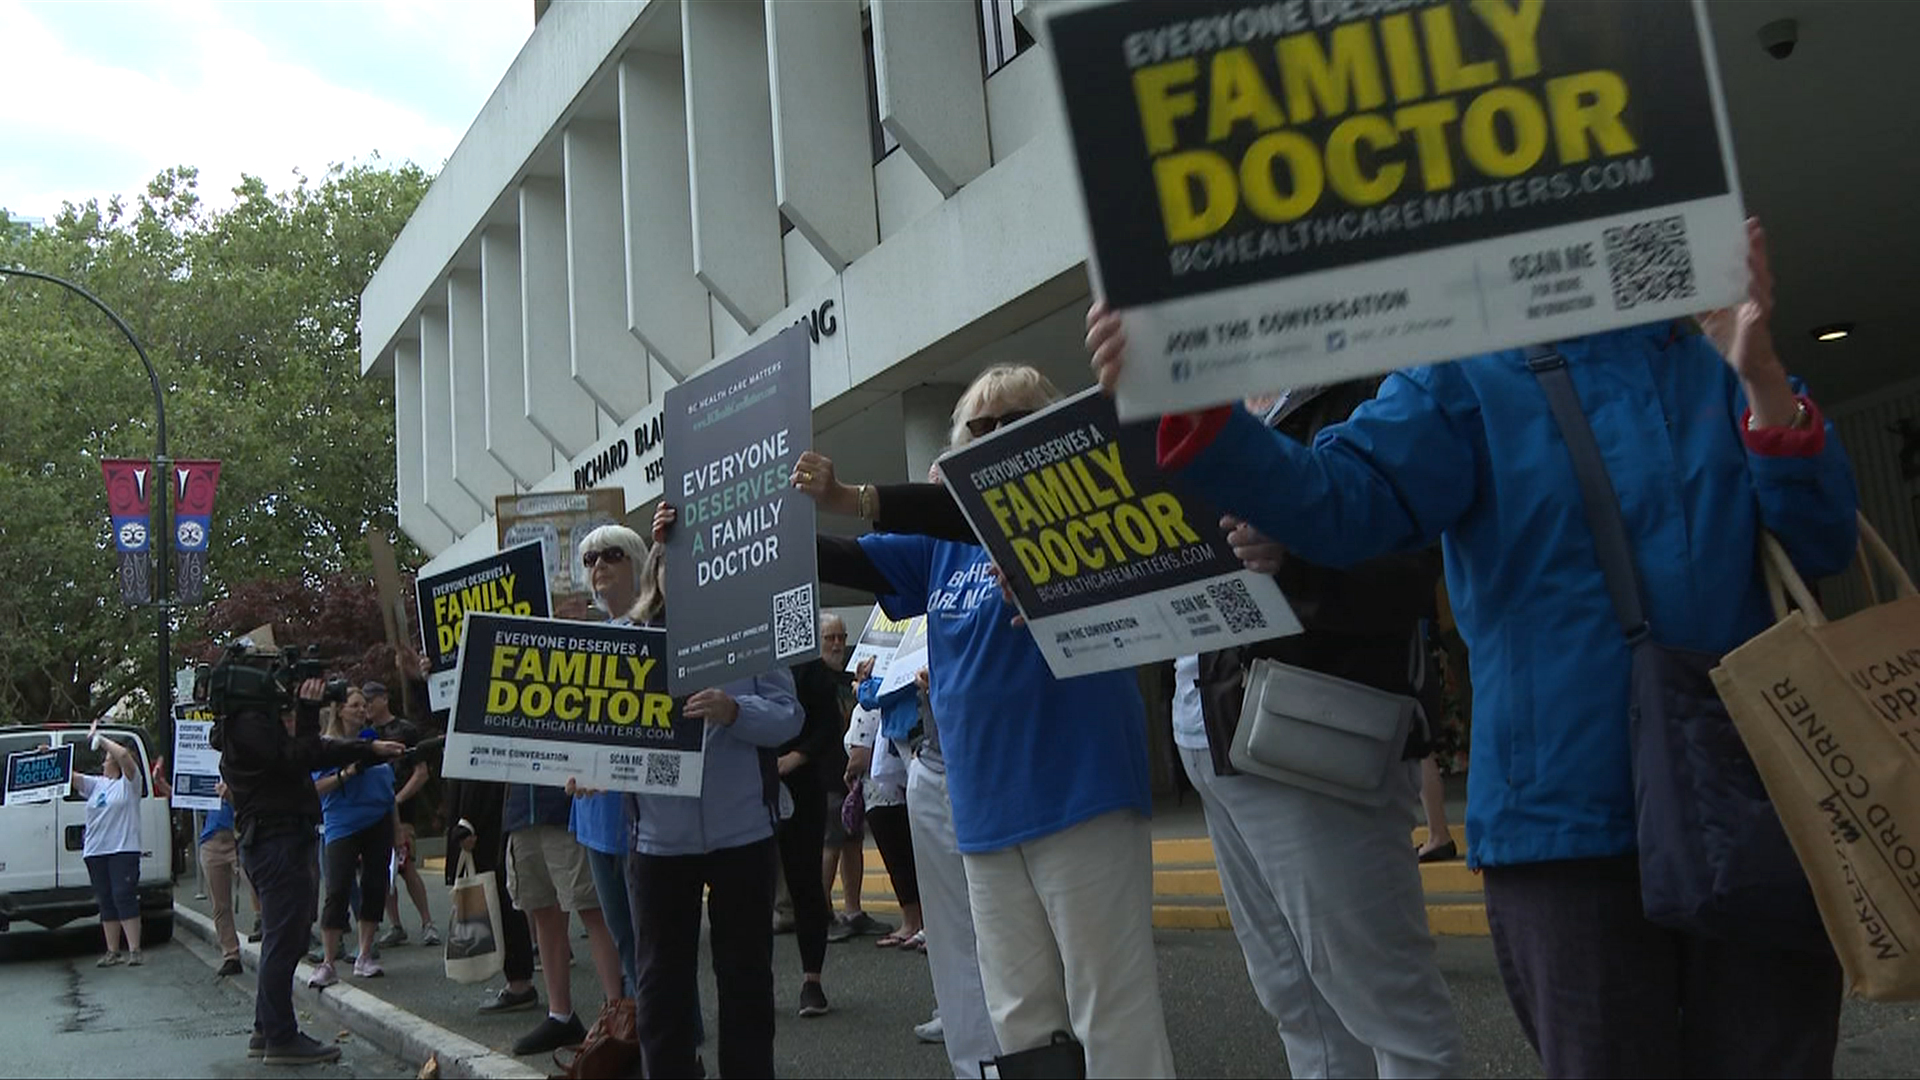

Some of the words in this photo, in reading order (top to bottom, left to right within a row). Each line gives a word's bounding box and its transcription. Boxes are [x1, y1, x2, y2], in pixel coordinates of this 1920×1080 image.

[1124, 2, 1308, 67] EVERYONE
[1132, 0, 1544, 156] FAMILY
[1152, 70, 1638, 244] DOCTOR
[1170, 155, 1654, 277] BCHEALTHCAREMATTERS.COM
[1509, 248, 1563, 282] SCAN
[1565, 242, 1597, 270] ME
[1257, 289, 1410, 336] CONVERSATION
[699, 390, 727, 409] HEALTH
[728, 378, 748, 396] CARE
[749, 360, 782, 385] MATTERS
[574, 438, 629, 492] RICHARD
[683, 428, 790, 498] EVERYONE
[969, 453, 1029, 491] EVERYONE
[1023, 428, 1091, 466] DESERVES
[1088, 423, 1105, 445] A
[685, 462, 790, 528] DESERVES
[980, 441, 1136, 539] FAMILY
[692, 531, 705, 557] A
[711, 499, 783, 549] FAMILY
[1010, 492, 1200, 586] DOCTOR
[432, 573, 468, 598] EVERYONE
[468, 565, 503, 587] DESERVES
[504, 562, 512, 576] A
[698, 534, 780, 587] DOCTOR
[1037, 546, 1217, 603] BCHEALTHCAREMATTERS.COM
[434, 573, 516, 627] FAMILY
[1170, 596, 1197, 616] SCAN
[490, 645, 657, 691] FAMILY
[495, 631, 566, 650] EVERYONE
[568, 637, 637, 656] DESERVES
[639, 644, 650, 657] A
[484, 715, 676, 741] BCHEALTHCAREMATTERS.COM
[486, 679, 674, 729] DOCTOR
[508, 748, 569, 762] CONVERSATION
[609, 753, 630, 765] SCAN
[1773, 676, 1870, 800] CORNER
[16, 757, 58, 775] FAMILY
[16, 767, 62, 785] DOCTOR
[1867, 802, 1920, 897] FORD
